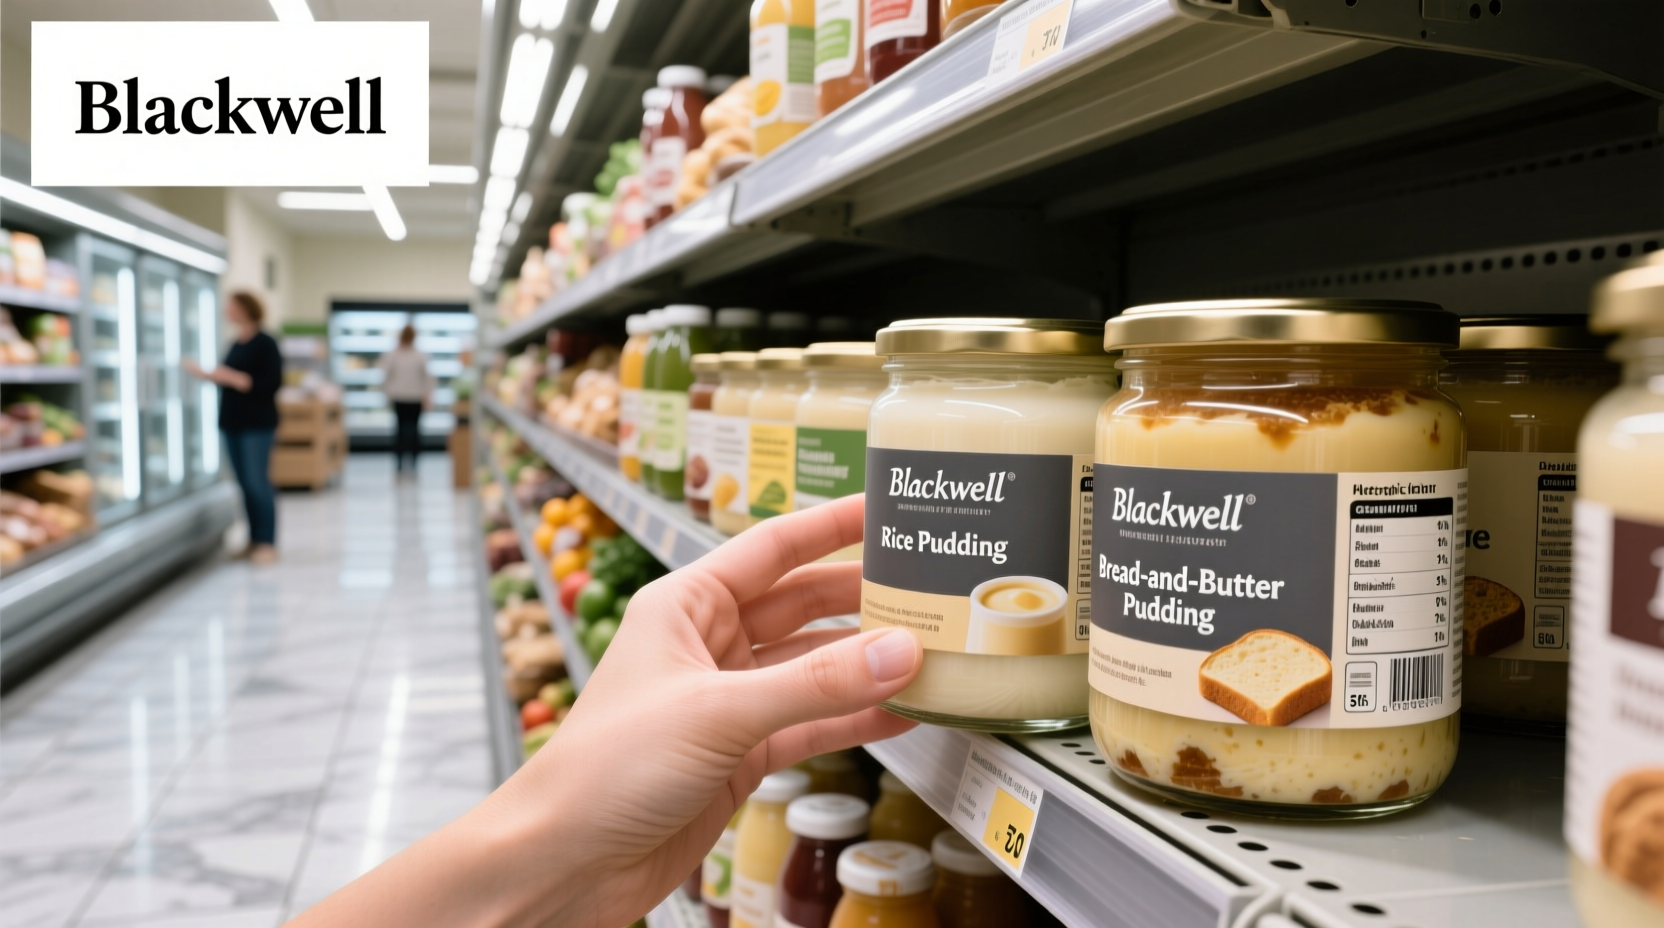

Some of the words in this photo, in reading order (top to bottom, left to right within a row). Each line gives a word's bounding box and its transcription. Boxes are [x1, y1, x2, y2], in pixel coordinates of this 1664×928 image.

[881, 525, 914, 551] Rice
[918, 530, 1009, 565] Pudding
[1099, 553, 1285, 600] Bread-and-Butter
[1123, 592, 1216, 636] Pudding
